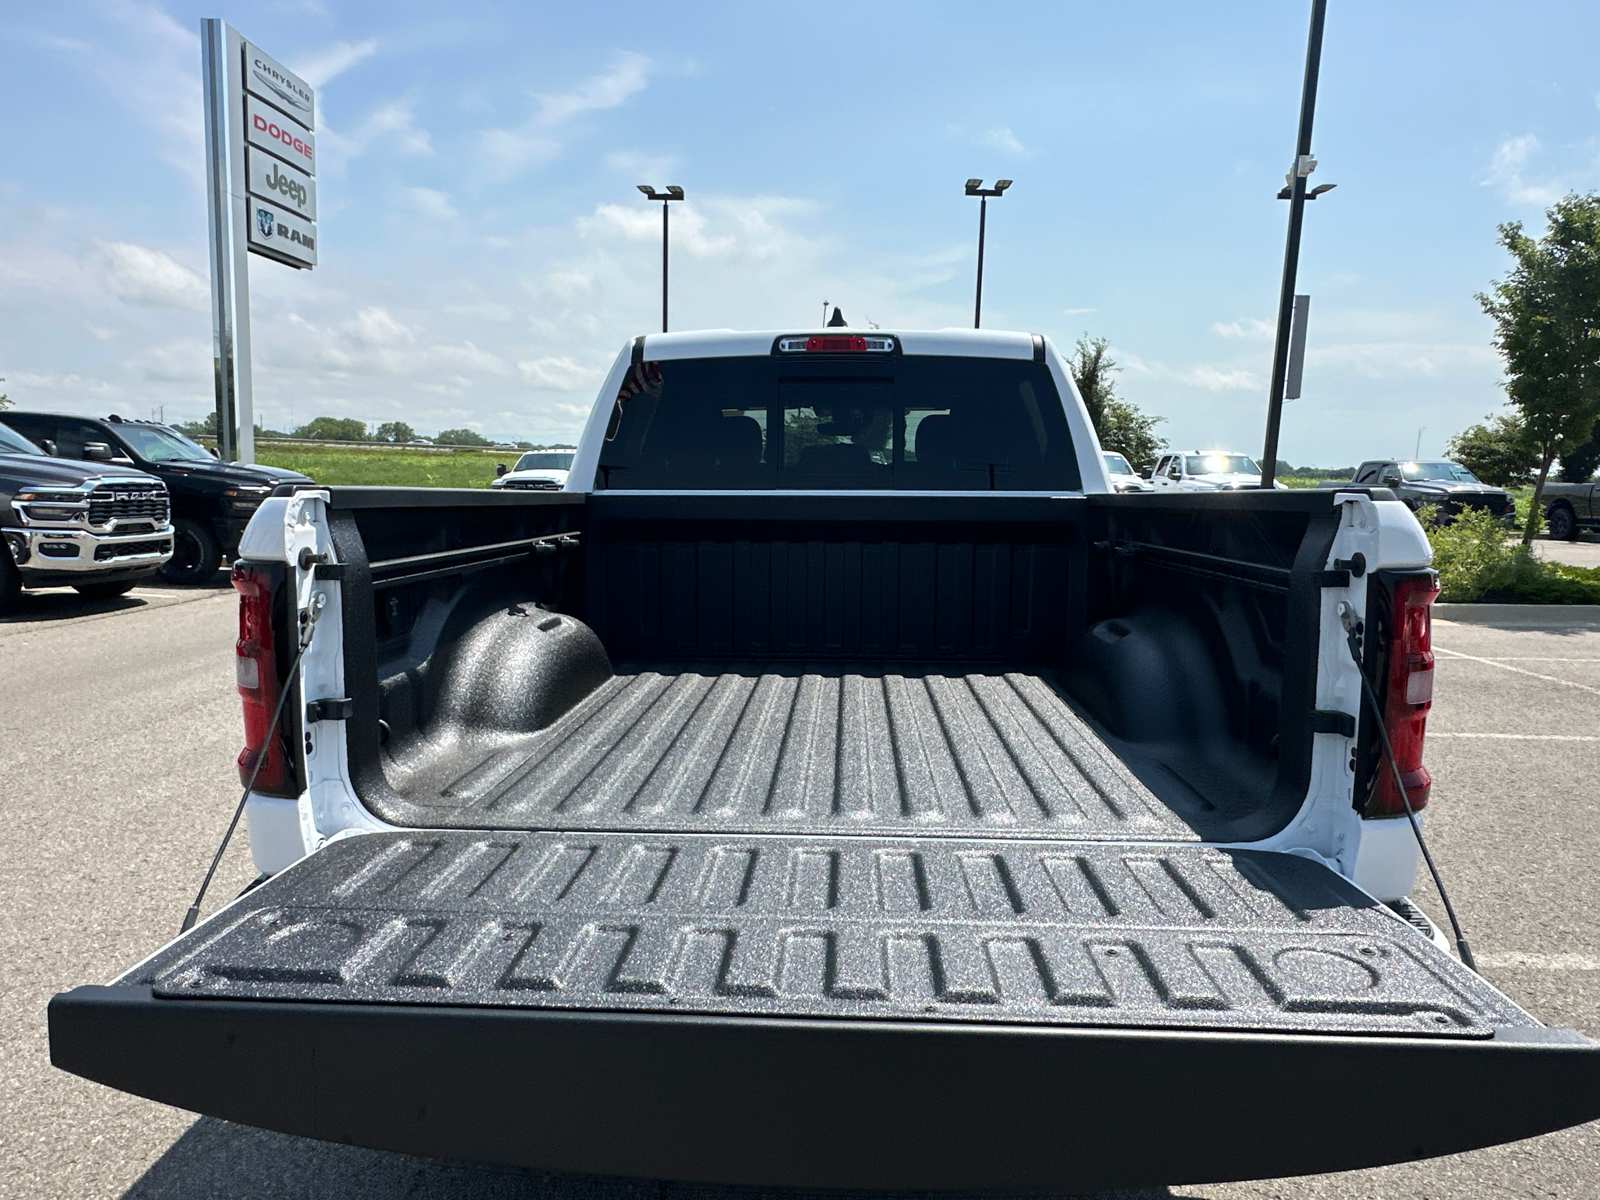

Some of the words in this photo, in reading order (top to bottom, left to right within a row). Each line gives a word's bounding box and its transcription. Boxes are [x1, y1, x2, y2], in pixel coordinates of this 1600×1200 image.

[254, 59, 310, 102] CHRYSLER
[253, 113, 312, 160] DODGE
[265, 163, 307, 209] Jeep
[277, 223, 315, 251] RAM
[115, 491, 156, 501] RAM
